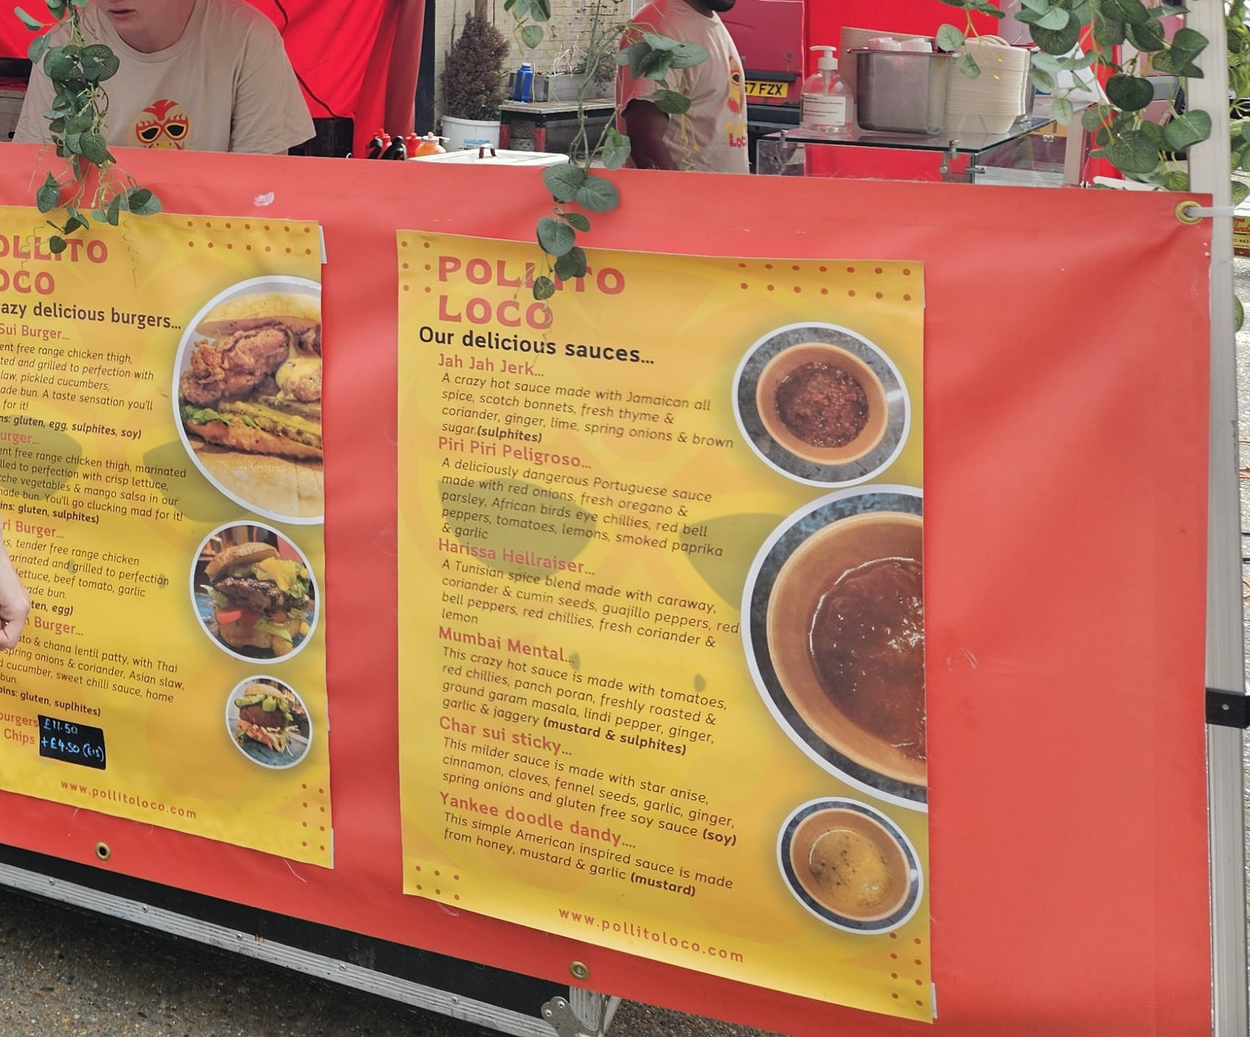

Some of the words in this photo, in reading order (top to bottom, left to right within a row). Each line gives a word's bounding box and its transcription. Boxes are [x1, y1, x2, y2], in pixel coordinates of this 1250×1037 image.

[759, 83, 783, 96] FZX
[33, 301, 105, 322] delicious
[439, 295, 554, 330] LOCO
[419, 326, 454, 345] Our
[462, 330, 556, 355] delicious
[16, 342, 35, 354] free
[38, 347, 65, 358] range
[67, 348, 103, 360] chicken
[107, 352, 132, 365] thigh,
[438, 353, 463, 368] Jah
[469, 356, 494, 372] Jah
[17, 358, 36, 368] and
[37, 360, 67, 372] grilled
[70, 363, 80, 373] to
[81, 365, 130, 377] perfection
[134, 371, 154, 380] with
[20, 373, 55, 385] pickled
[57, 378, 109, 392] cucumbers,
[441, 373, 450, 383] A
[454, 376, 487, 389] crazy
[490, 377, 510, 390] hot
[514, 382, 551, 394] sauce
[555, 387, 591, 398] made
[596, 390, 622, 401] with
[626, 391, 689, 408] Jamaican
[694, 400, 710, 411] all
[3, 398, 17, 411] for
[19, 401, 29, 411] it!
[20, 386, 39, 397] bun.
[42, 389, 49, 399] A
[52, 391, 76, 401] taste
[79, 395, 124, 407] sensation
[128, 400, 153, 410] you'll
[442, 389, 475, 403] spice,
[479, 395, 519, 407] scotch
[524, 397, 576, 414] bonnets,
[581, 403, 614, 417] fresh
[619, 408, 660, 423] thyme
[664, 412, 674, 424] &
[13, 415, 45, 428] gluten,
[72, 422, 117, 436] sulphites,
[121, 429, 142, 440] soy)
[442, 406, 500, 423] coriander,
[505, 412, 546, 428] ginger,
[551, 417, 579, 432] lime,
[584, 423, 624, 438] spring
[629, 428, 673, 441] onions
[677, 432, 688, 443] &
[692, 433, 733, 448] brown
[442, 423, 542, 443] sugar.(sulphites)
[439, 436, 464, 452] Piri
[470, 440, 496, 457] Piri
[15, 447, 33, 458] free
[36, 452, 62, 464] range
[65, 454, 102, 468] chicken
[105, 459, 132, 473] thigh,
[135, 465, 186, 478] marinated
[441, 457, 450, 468] A
[454, 459, 519, 479] deliciously
[523, 468, 589, 487] dangerous
[593, 477, 668, 497] Portuguese
[672, 489, 712, 503] sauce
[439, 537, 495, 559] Harissa
[439, 625, 501, 650] Mumbai
[444, 646, 466, 660] This
[470, 654, 503, 670] crazy
[507, 659, 527, 673] hot
[531, 666, 568, 680] sauce
[573, 671, 582, 683] is
[587, 676, 623, 691] made
[628, 683, 655, 696] with
[660, 687, 726, 710] tomatoes,
[20, 691, 51, 706] gluten,
[54, 700, 101, 717] suplhites)
[4, 728, 35, 746] Chips
[43, 718, 78, 734] £11.50
[439, 716, 477, 735] Char
[482, 727, 505, 741] sui
[443, 699, 476, 712] garlic
[480, 704, 489, 715] &
[493, 706, 539, 727] jaggery
[544, 716, 601, 738] (mustard
[605, 729, 616, 741] &
[620, 734, 686, 756] sulphites)
[61, 781, 196, 819] www.pollitoloco.com
[440, 791, 499, 817] Yankee
[505, 806, 563, 831] doodle
[444, 827, 472, 843] from
[476, 835, 515, 855] honey,
[520, 848, 572, 866] mustard
[576, 859, 586, 870] &
[590, 864, 626, 880] garlic
[631, 872, 696, 897] (mustard)
[445, 811, 468, 827] This
[471, 820, 511, 837] simple
[515, 829, 575, 851] American
[579, 843, 631, 864] inspired
[635, 859, 674, 875] sauce
[679, 866, 690, 879] is
[695, 872, 733, 889] made
[559, 909, 743, 963] www.pollitoloco.com
